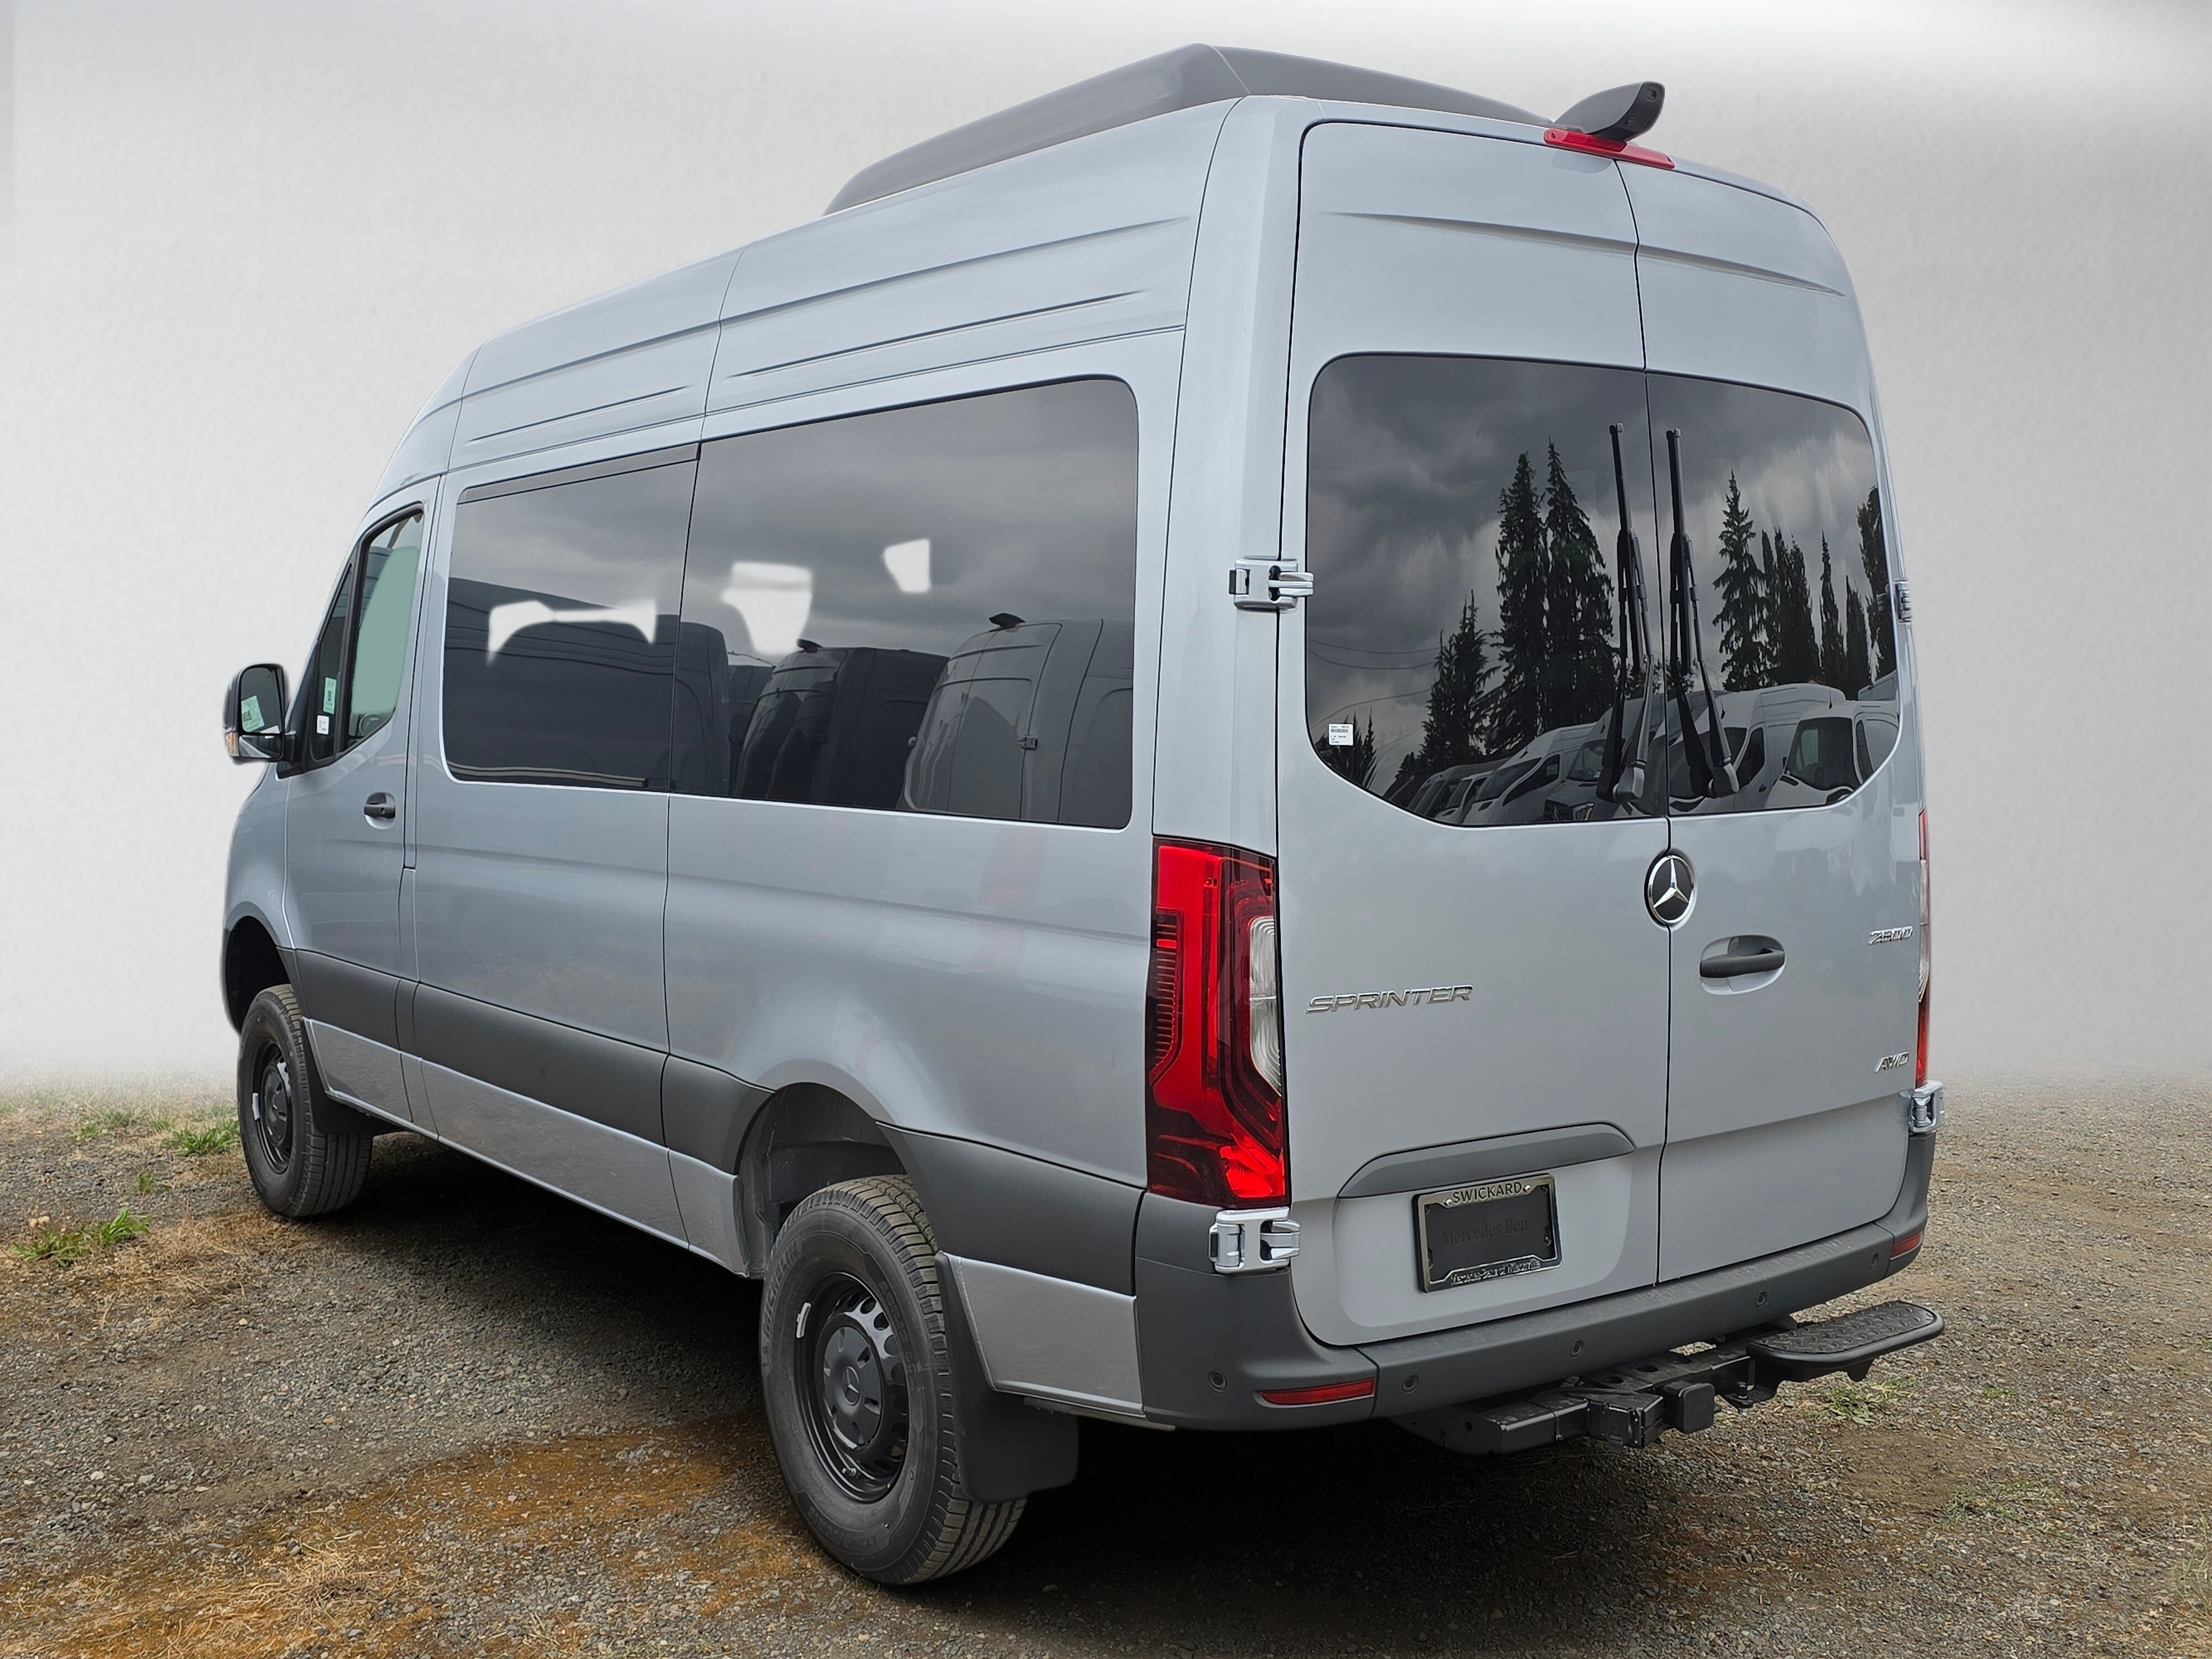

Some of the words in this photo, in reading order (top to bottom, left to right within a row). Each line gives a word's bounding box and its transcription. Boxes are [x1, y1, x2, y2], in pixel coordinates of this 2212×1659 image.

[1305, 984, 1474, 1014] SPRINTER
[1453, 1182, 1522, 1203] SWICKARD
[1442, 1218, 1535, 1245] Mercedes-Benz
